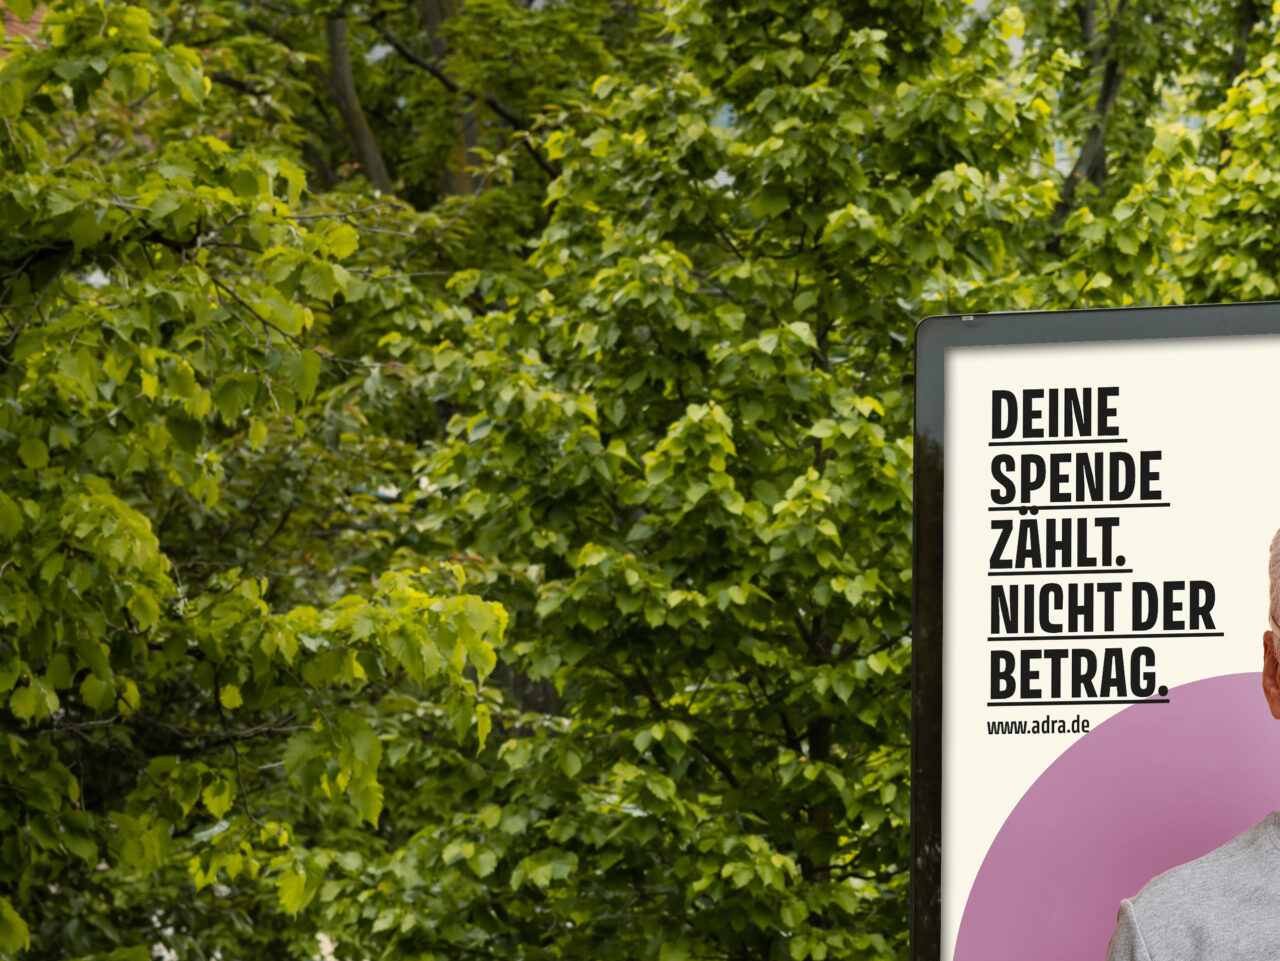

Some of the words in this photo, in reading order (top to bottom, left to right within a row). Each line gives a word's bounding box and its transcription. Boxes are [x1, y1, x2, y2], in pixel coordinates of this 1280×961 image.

[991, 386, 1120, 440] DEINE
[990, 450, 1163, 505] SPENDE
[989, 505, 1126, 570] ZÄHLT.
[990, 582, 1122, 635] NICHT
[1131, 580, 1217, 632] DER
[990, 646, 1169, 700] BETRAG.
[987, 714, 1091, 735] www.adra.de
